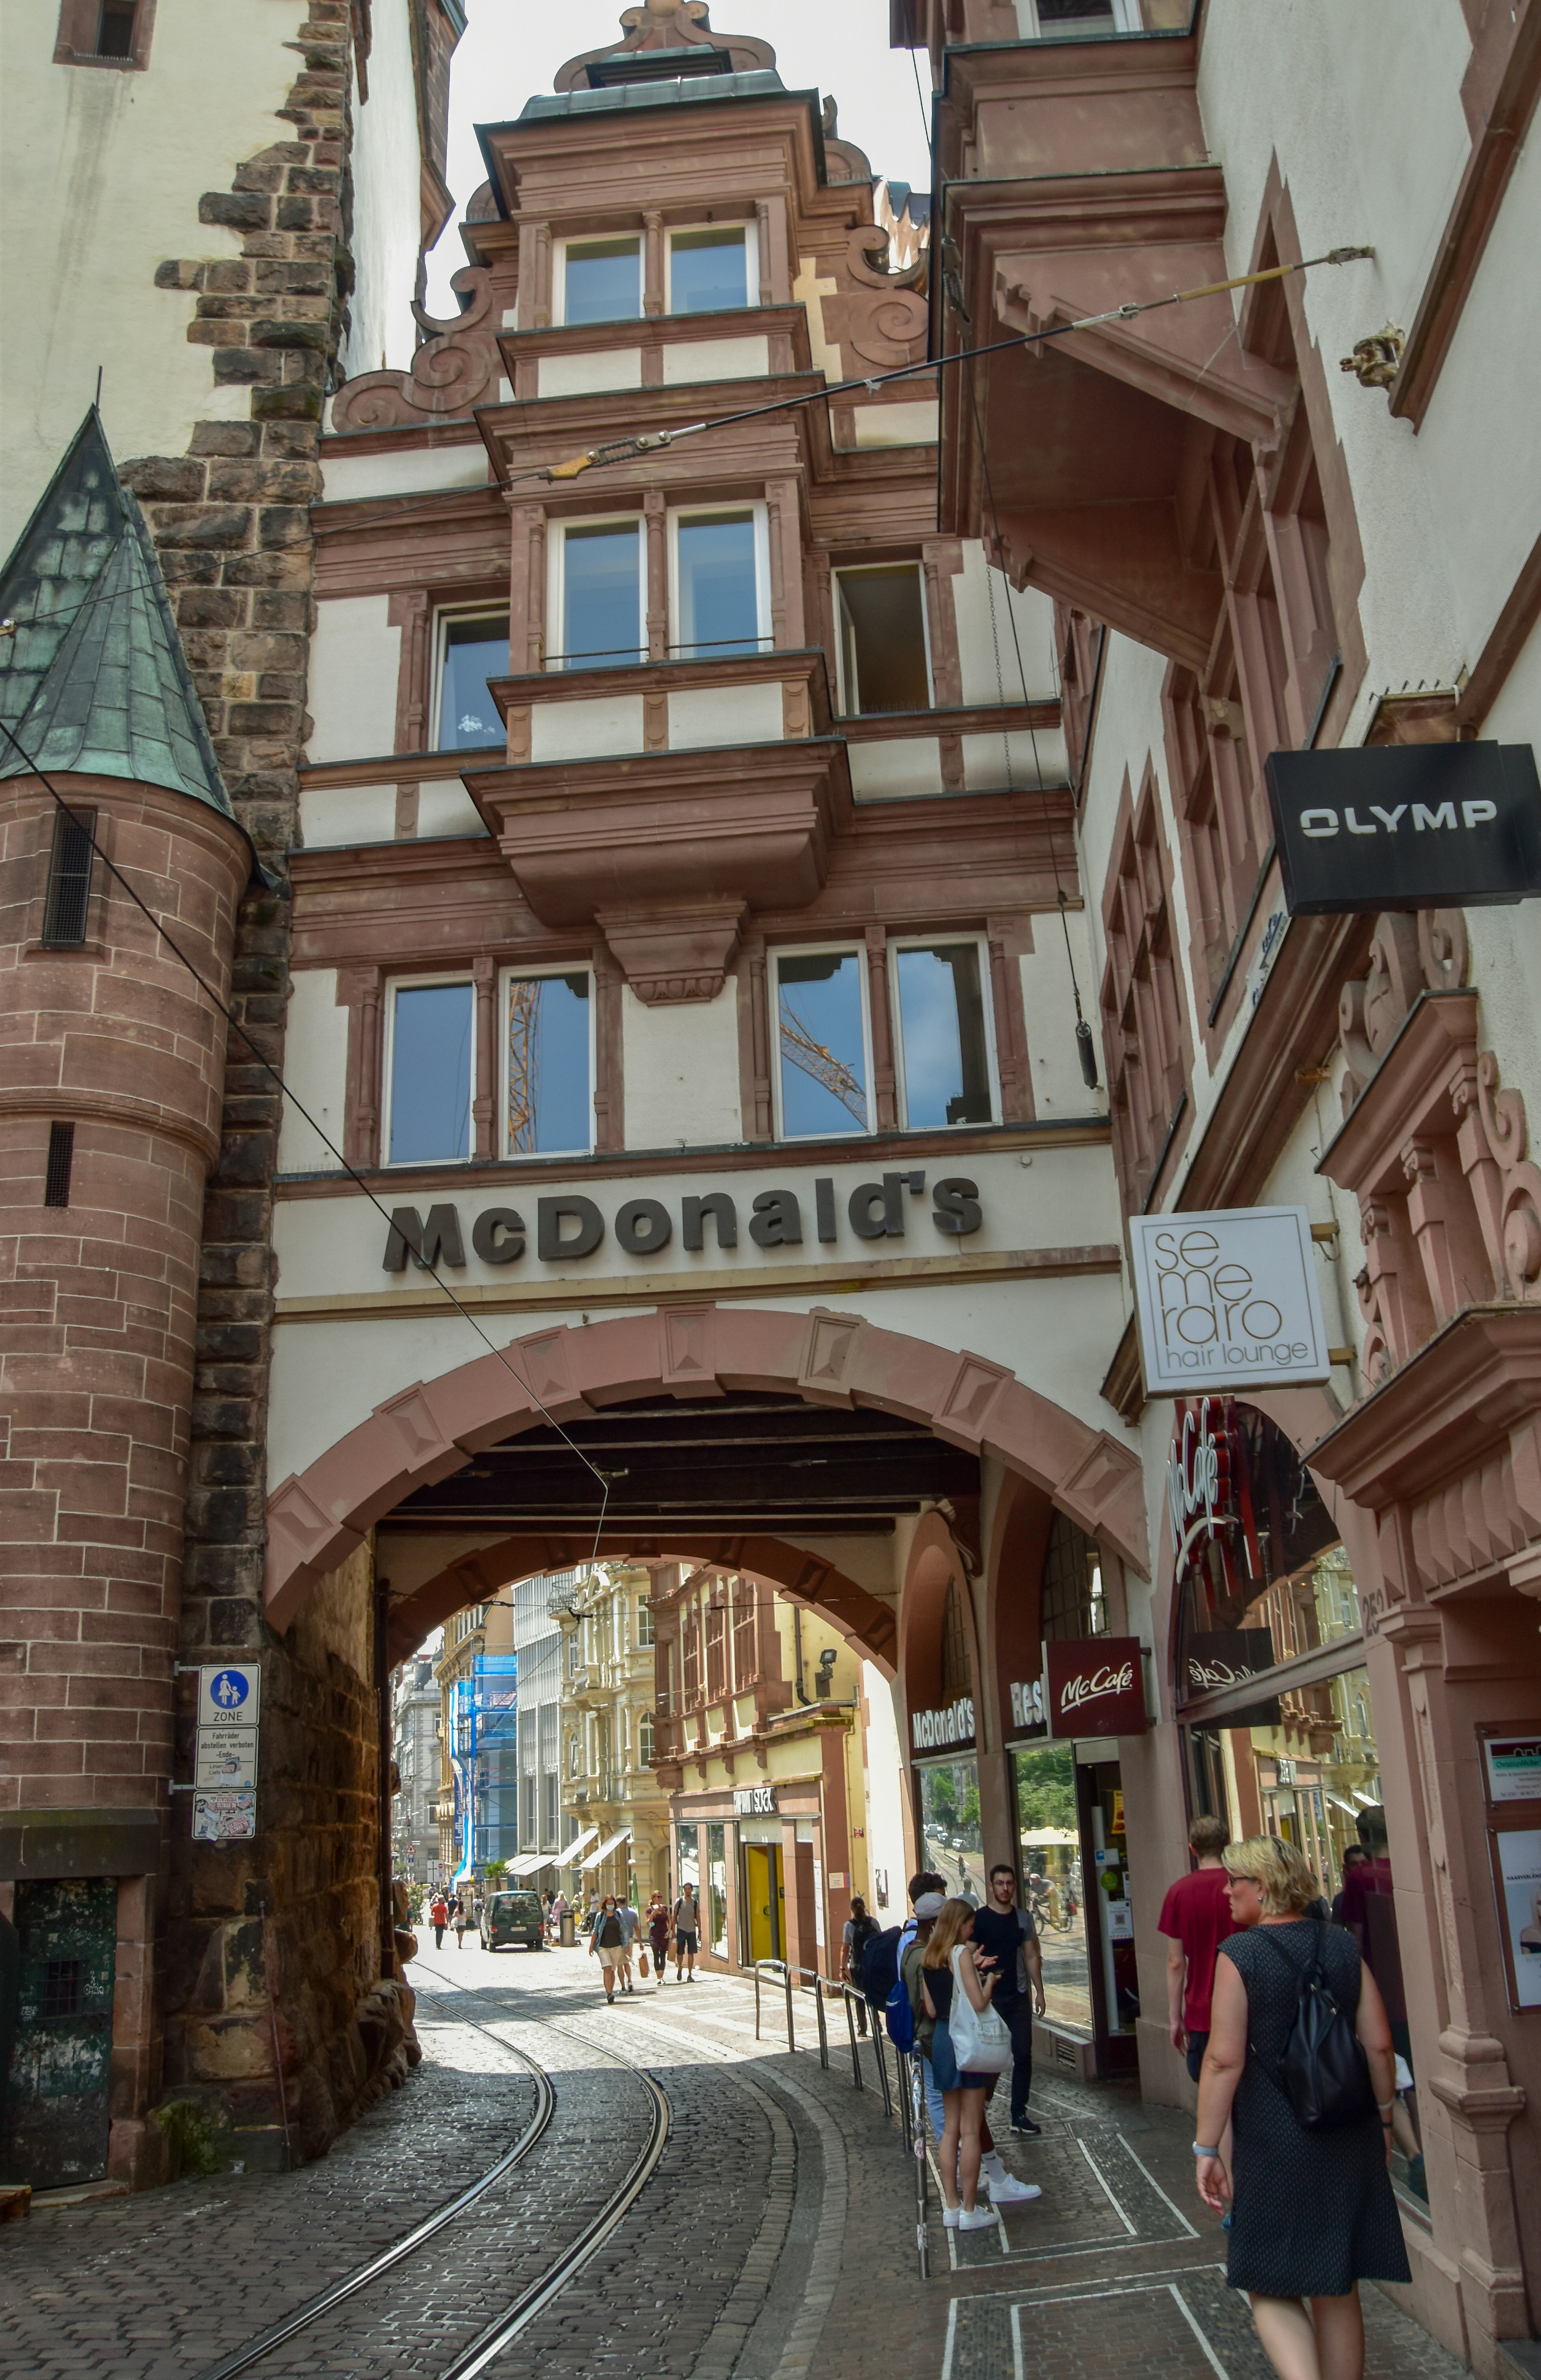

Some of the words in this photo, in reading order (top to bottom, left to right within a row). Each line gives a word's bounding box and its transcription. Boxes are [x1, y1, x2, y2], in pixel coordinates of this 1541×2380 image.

[1300, 800, 1497, 837] OLYMP
[382, 1170, 983, 1273] McDonald's
[1154, 1230, 1219, 1271] se
[1158, 1264, 1253, 1306] me
[1162, 1300, 1282, 1345] raro
[1166, 1345, 1214, 1368] hair
[1223, 1342, 1308, 1365] lounge
[1061, 1662, 1133, 1707] McCafé
[214, 1712, 243, 1722] ZONE
[912, 1697, 975, 1748] McDonald's
